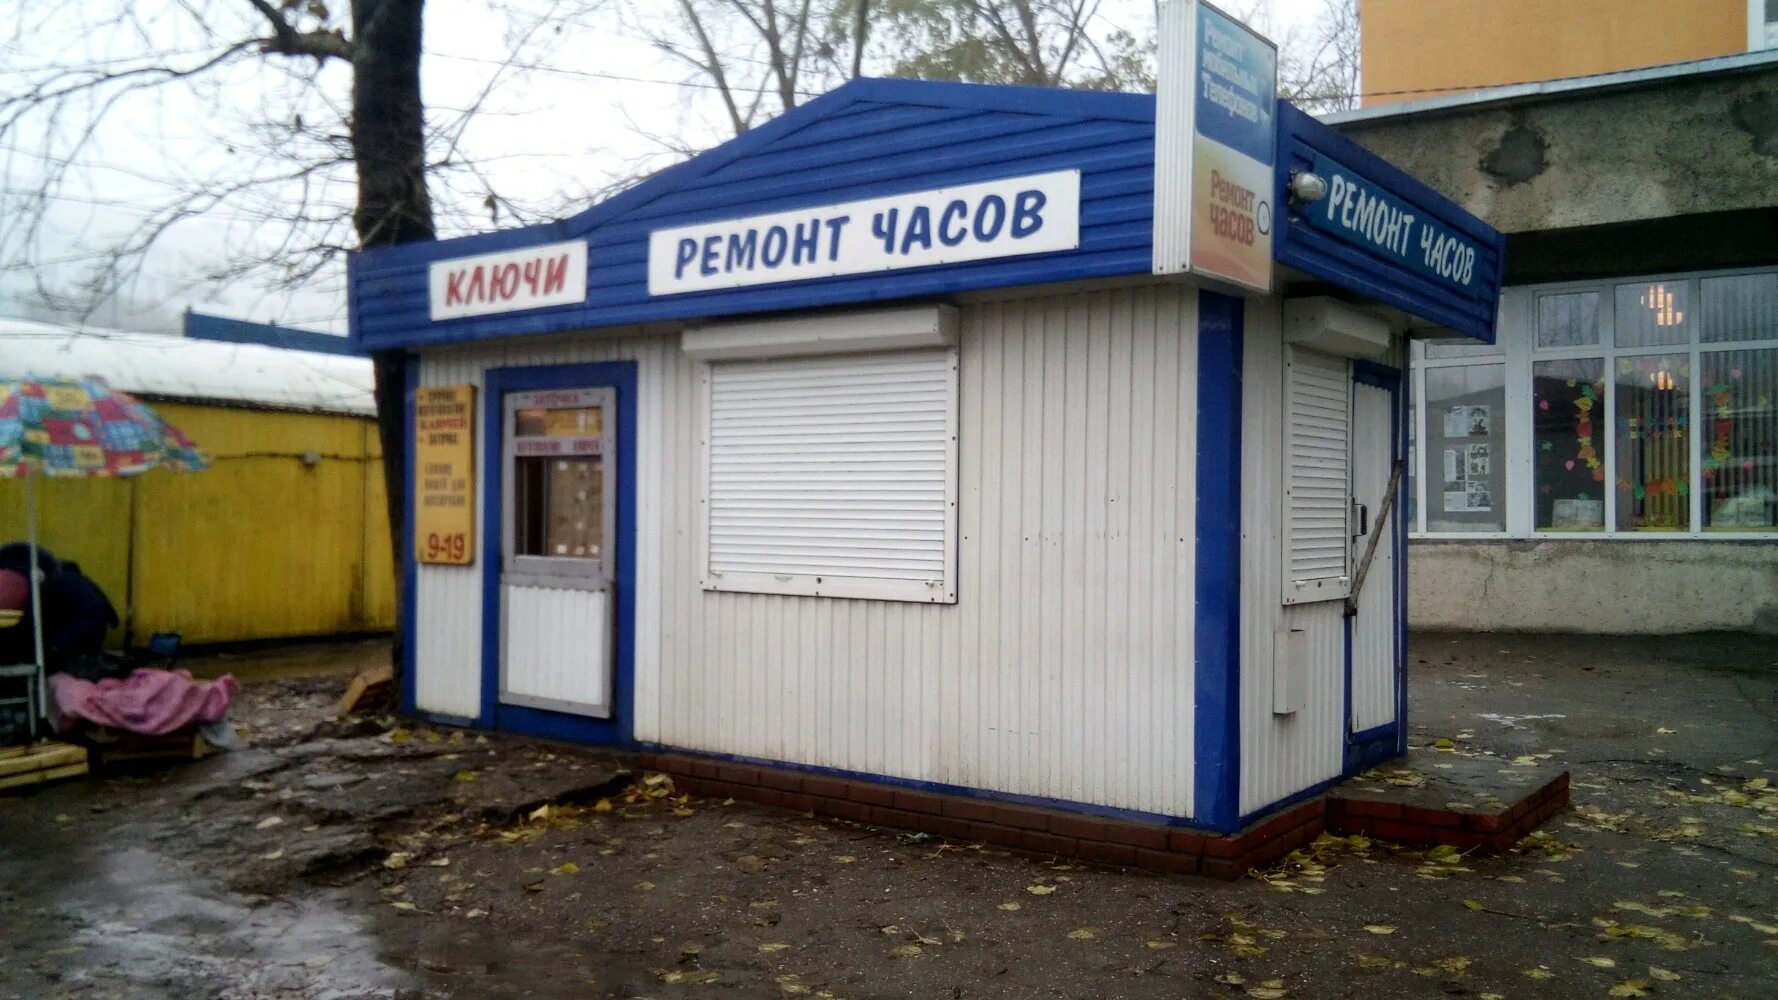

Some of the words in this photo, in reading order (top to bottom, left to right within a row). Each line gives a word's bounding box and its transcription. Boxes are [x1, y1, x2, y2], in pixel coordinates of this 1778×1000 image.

[1210, 169, 1255, 213] Ремонт
[674, 215, 850, 280] РЕМОНТ
[872, 189, 1047, 256] ЧАСОВ
[1327, 174, 1415, 257] РЕМОНТ
[1420, 223, 1475, 286] ЧАСОВ
[446, 252, 569, 307] КЛЮЧИ
[428, 533, 465, 561] 9-19
